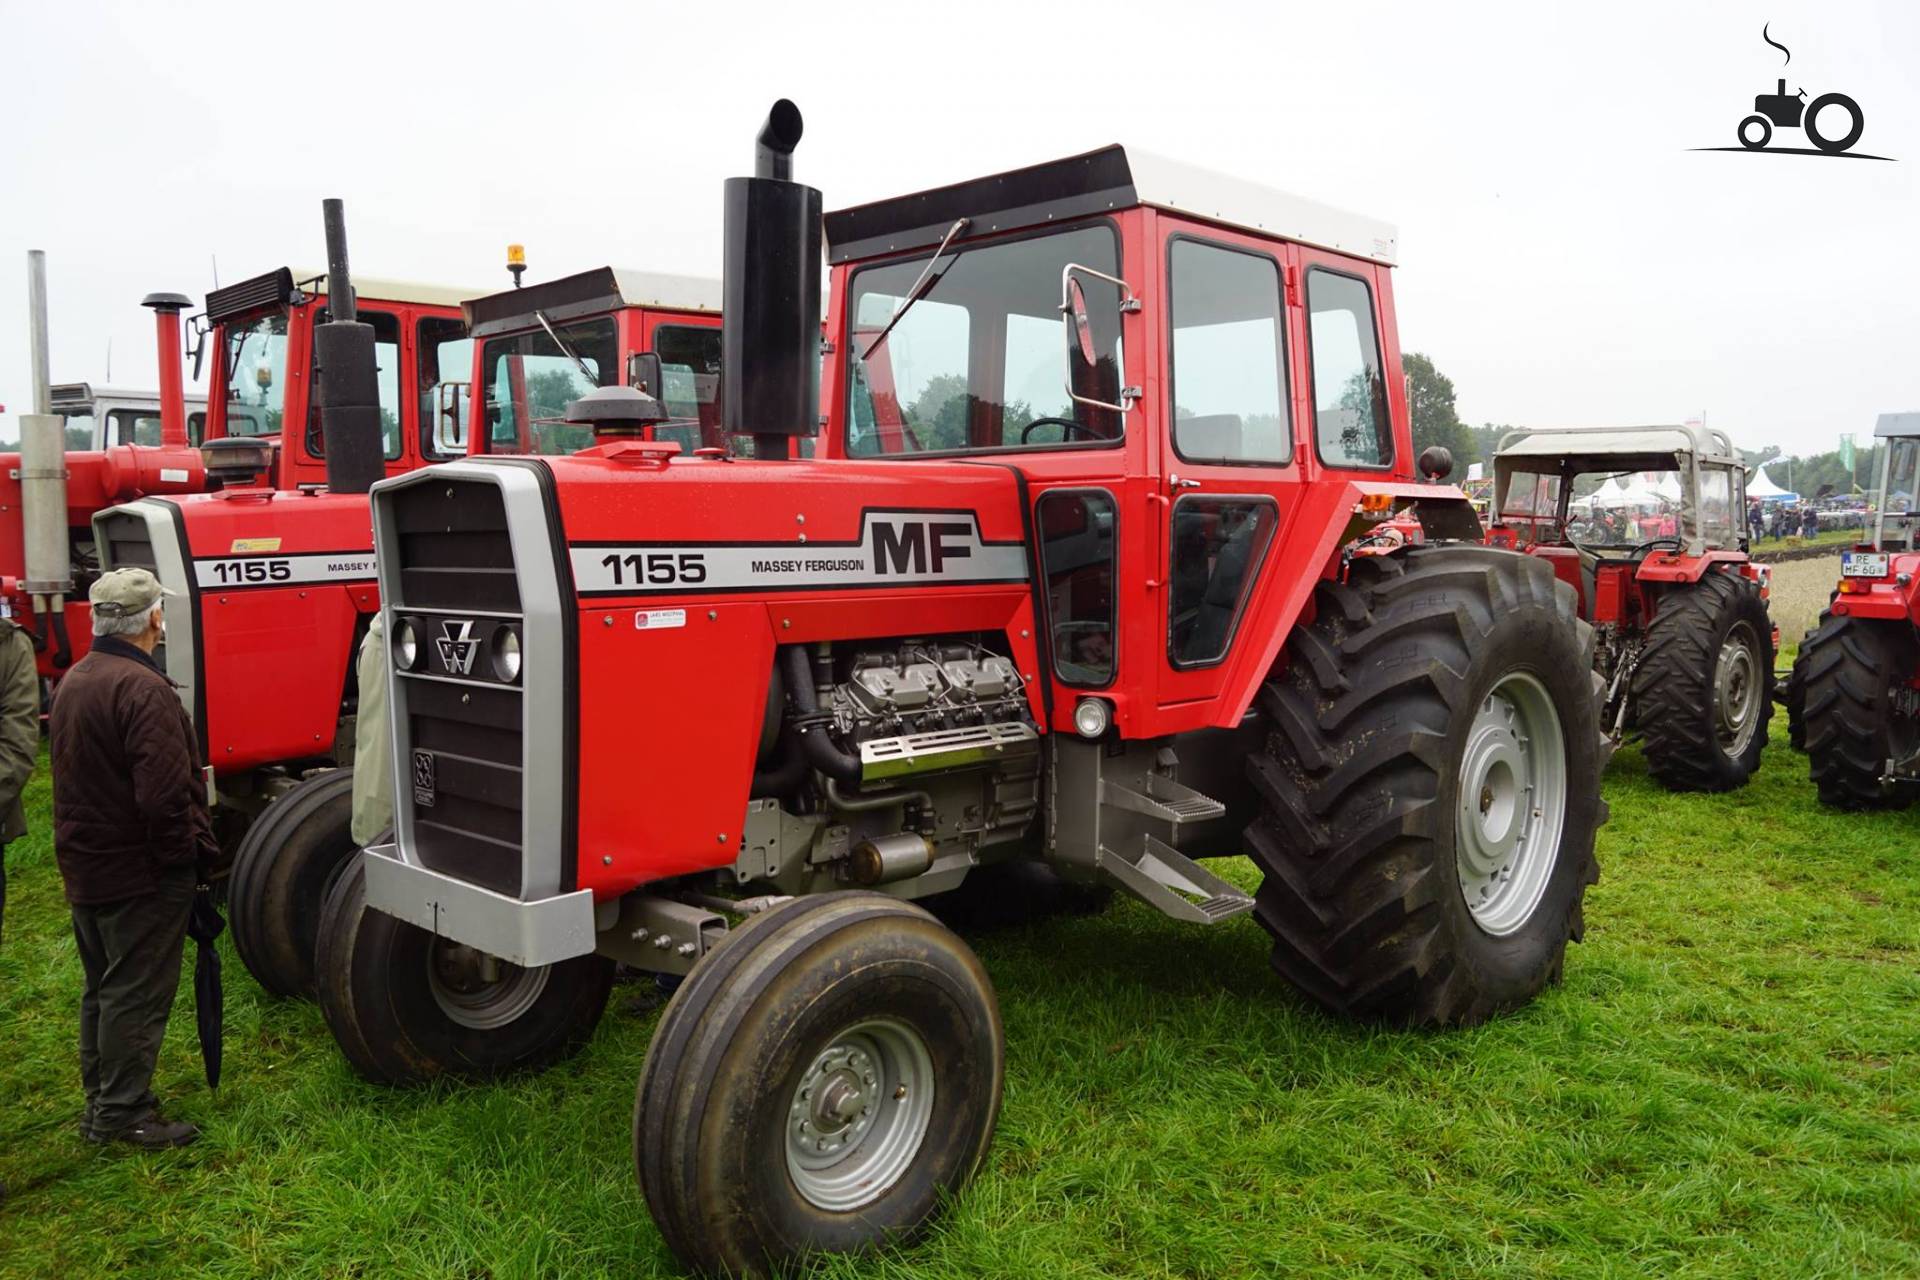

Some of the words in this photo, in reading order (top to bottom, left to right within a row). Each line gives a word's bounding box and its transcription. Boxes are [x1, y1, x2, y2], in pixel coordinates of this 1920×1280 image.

[872, 522, 972, 575] MF
[1856, 555, 1869, 565] RE
[213, 560, 291, 583] 1155
[328, 562, 368, 572] MASSEY
[602, 554, 706, 585] 1155
[752, 560, 801, 574] MASSEY
[805, 558, 864, 572] FERGUSON
